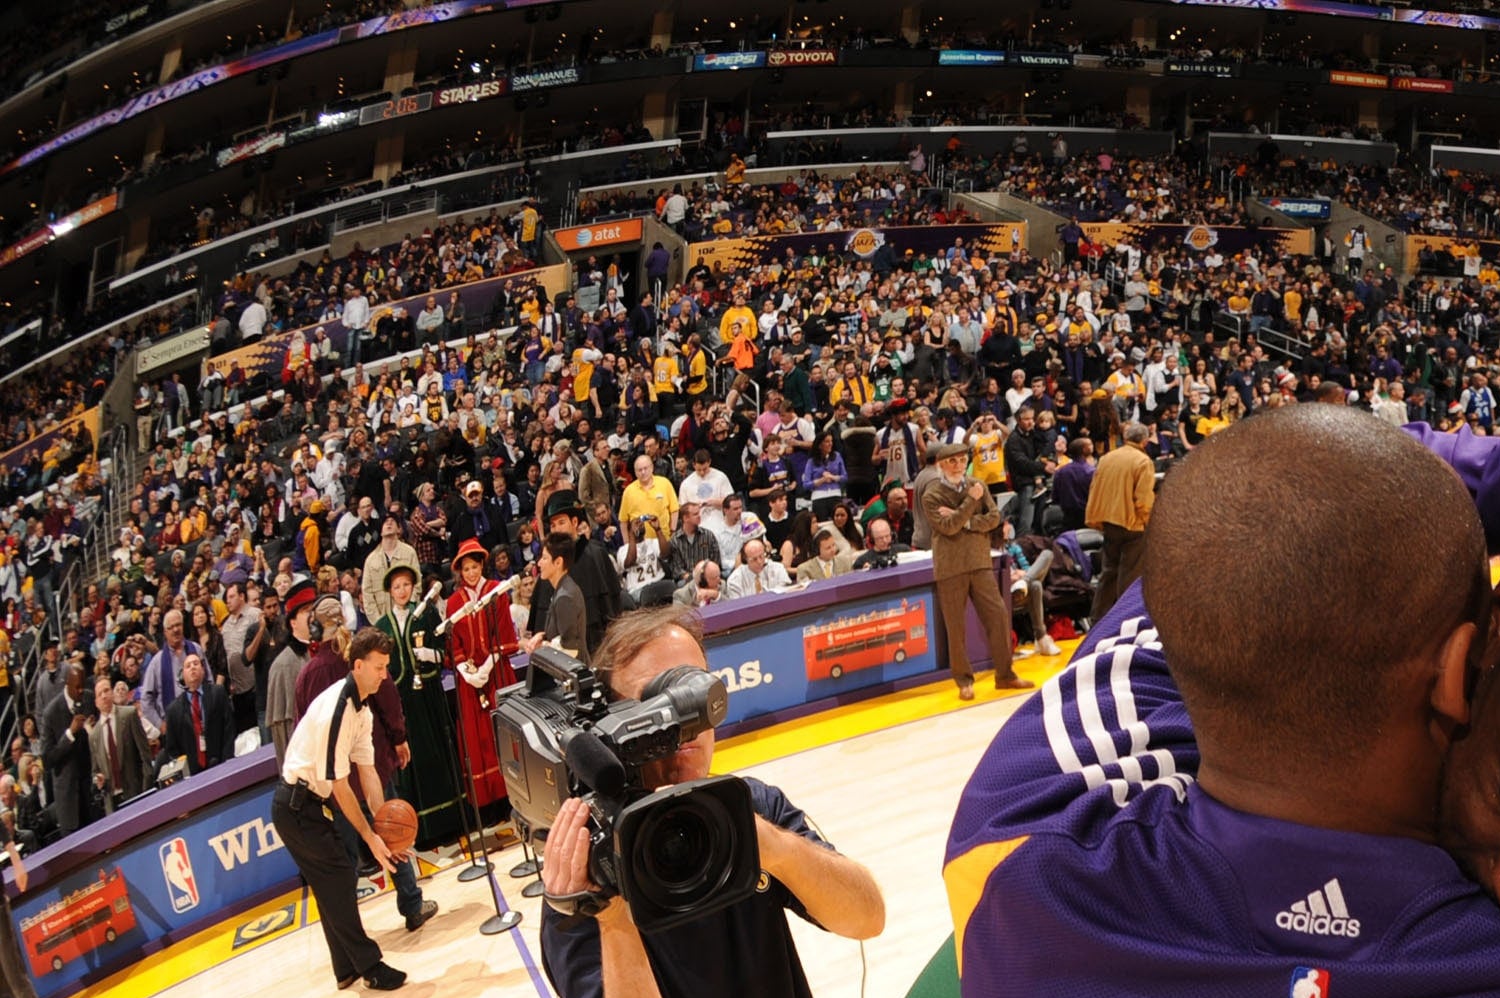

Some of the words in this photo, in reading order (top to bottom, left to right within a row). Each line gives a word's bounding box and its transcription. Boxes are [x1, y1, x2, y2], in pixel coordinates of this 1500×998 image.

[714, 54, 758, 66] PEPSI
[789, 52, 835, 64] TOYOTA
[940, 53, 975, 62] American
[976, 54, 1005, 63] Express
[1019, 55, 1070, 66] WACHOVIA
[511, 75, 532, 88] SAN
[538, 69, 579, 84] MANUEL
[439, 80, 501, 104] STAPLES
[1280, 202, 1323, 214] PEPSI
[151, 338, 183, 361] Sempra
[889, 446, 902, 463] 16
[980, 449, 998, 464] 32
[636, 563, 656, 583] 24
[710, 659, 774, 694] ns.
[1275, 910, 1361, 938] adidas
